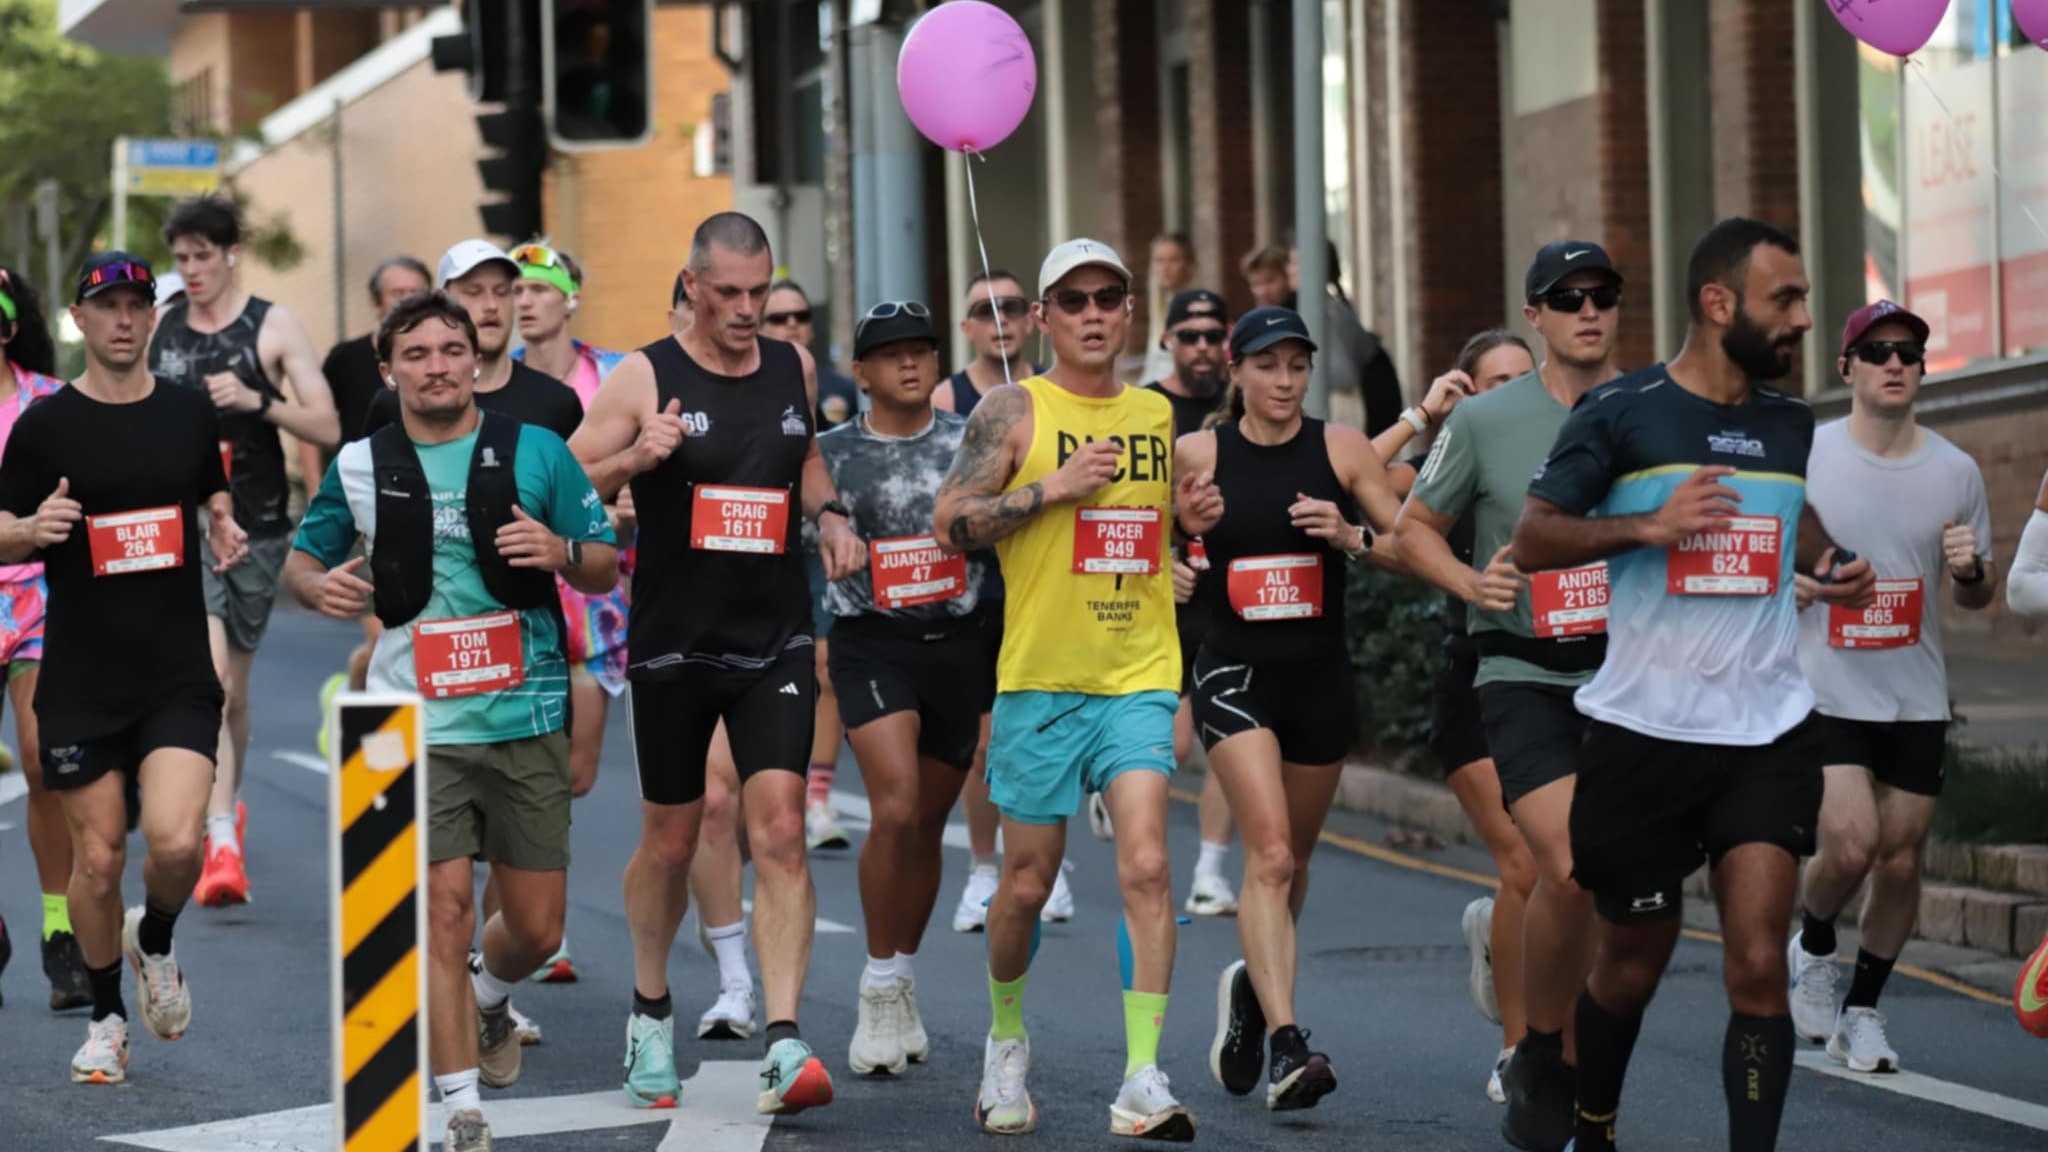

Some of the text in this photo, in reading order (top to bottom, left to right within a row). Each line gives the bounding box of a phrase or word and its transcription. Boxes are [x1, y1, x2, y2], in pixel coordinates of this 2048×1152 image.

[1919, 113, 1977, 190] LEASE
[1057, 430, 1168, 483] PCER
[721, 502, 767, 519] CRAIG
[116, 523, 160, 542] BLAIR
[723, 519, 762, 537] 1611
[1097, 523, 1143, 539] PACER
[124, 539, 155, 557] 264
[1105, 541, 1135, 557] 949
[1678, 533, 1776, 554] DANNY BEE
[1712, 553, 1750, 574] 624
[912, 565, 932, 582] 47
[1265, 569, 1291, 586] ALI
[1256, 586, 1300, 604] 1702
[1563, 586, 1607, 608] 2185
[1863, 609, 1893, 625] 665
[449, 631, 488, 650] TOM
[447, 648, 492, 669] 1971
